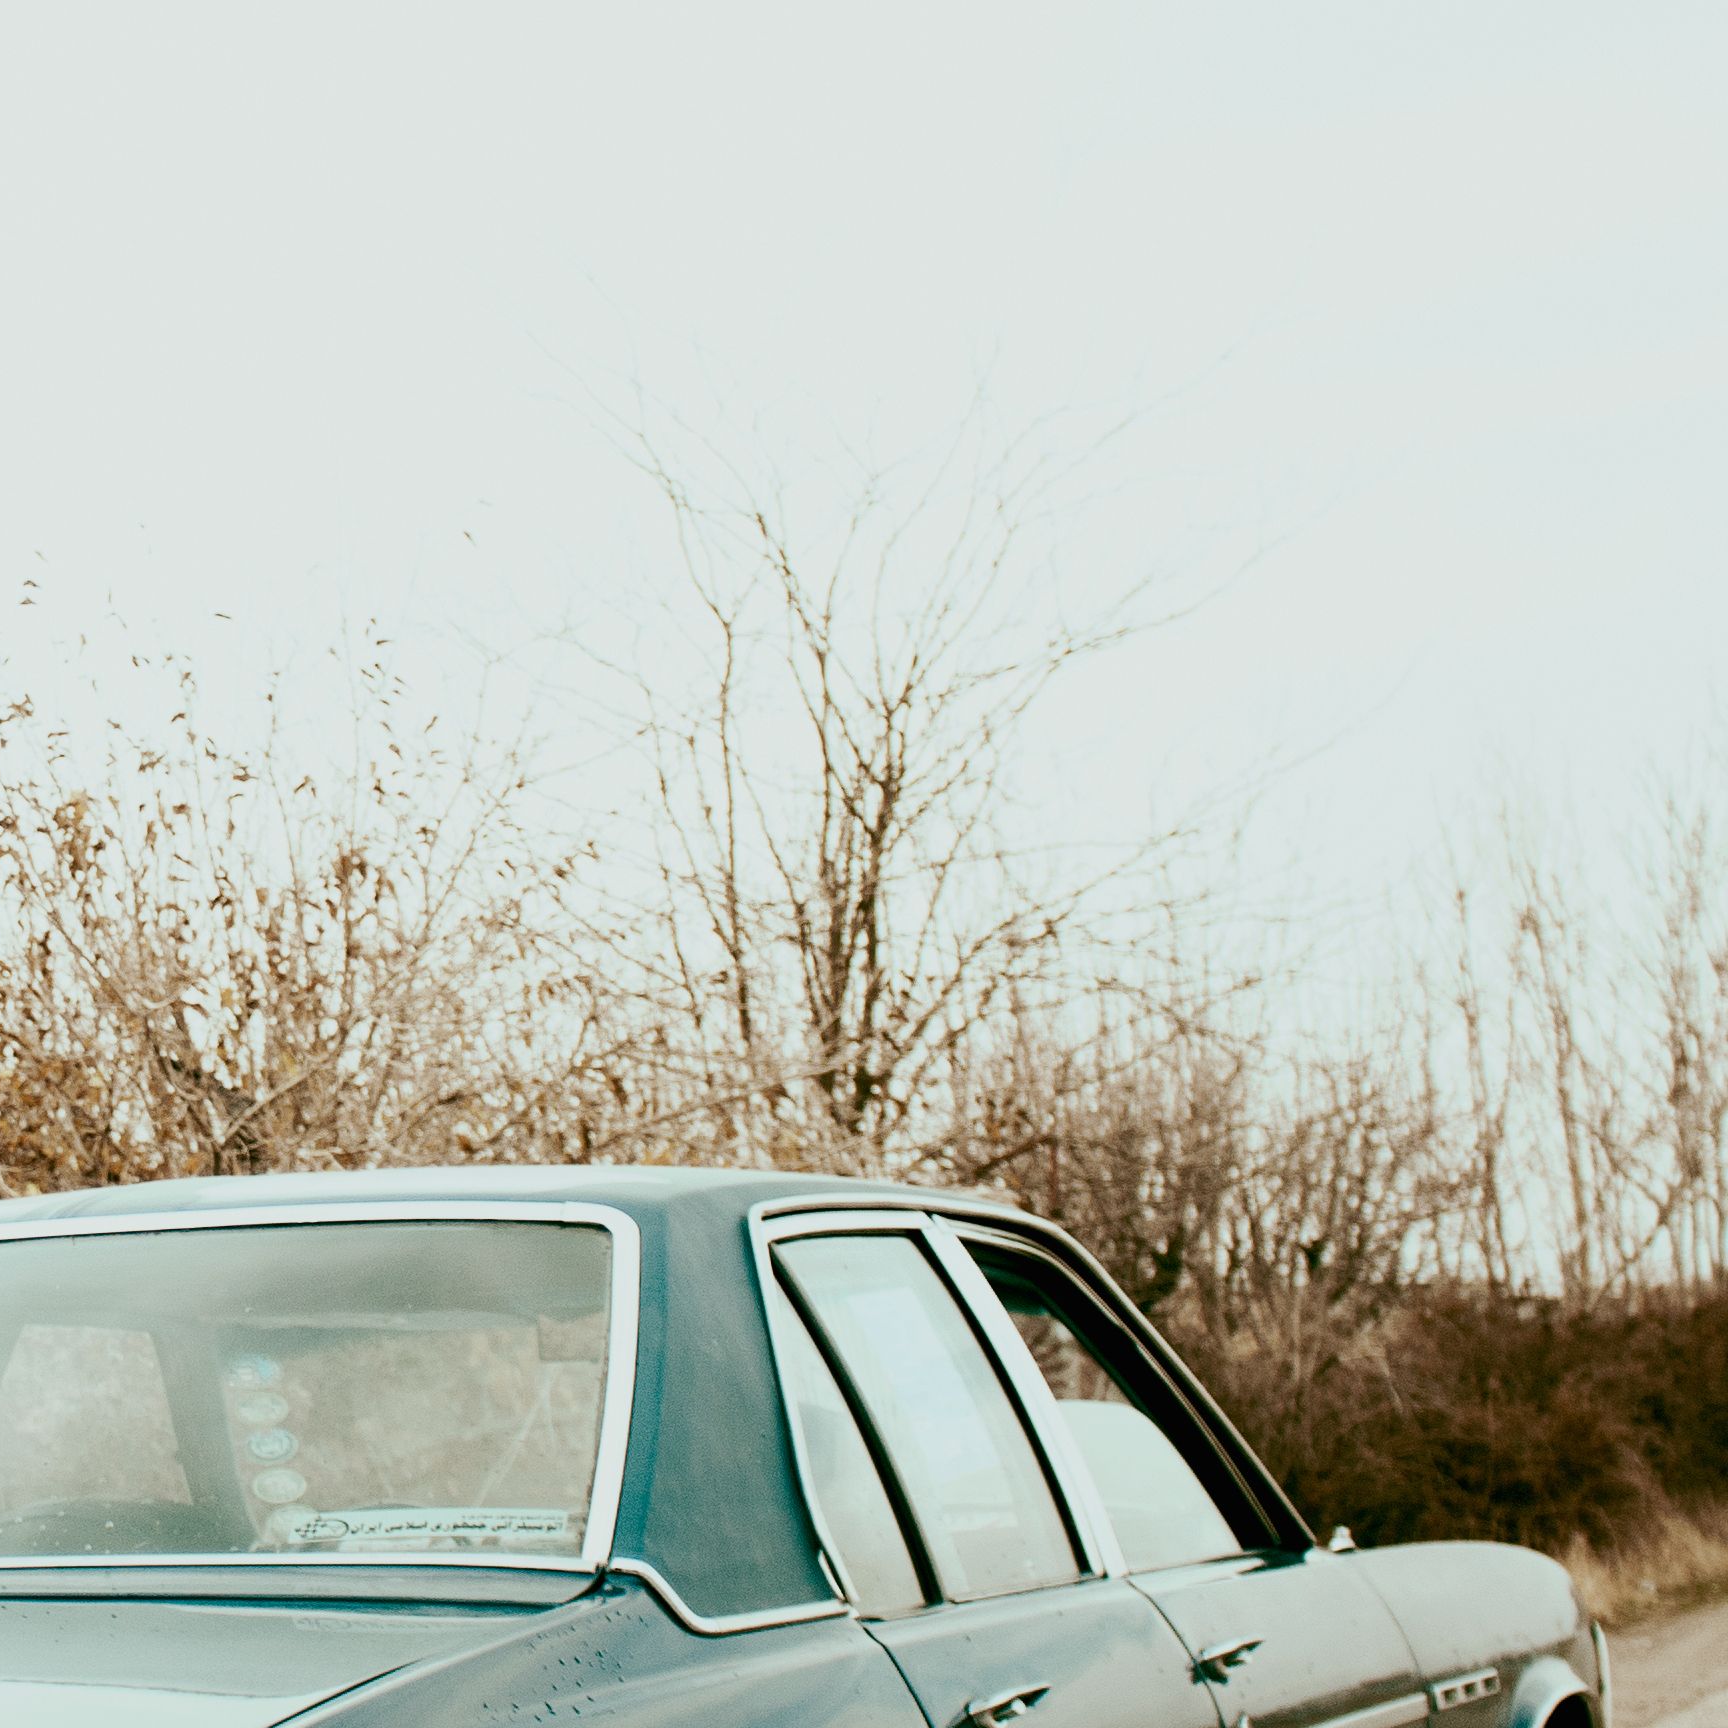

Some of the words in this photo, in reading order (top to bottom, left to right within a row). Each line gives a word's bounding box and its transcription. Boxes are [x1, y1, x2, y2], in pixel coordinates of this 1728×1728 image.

[350, 1522, 382, 1535] ایران
[384, 1520, 428, 1533] اسلامی
[431, 1521, 486, 1533] جمهوری
